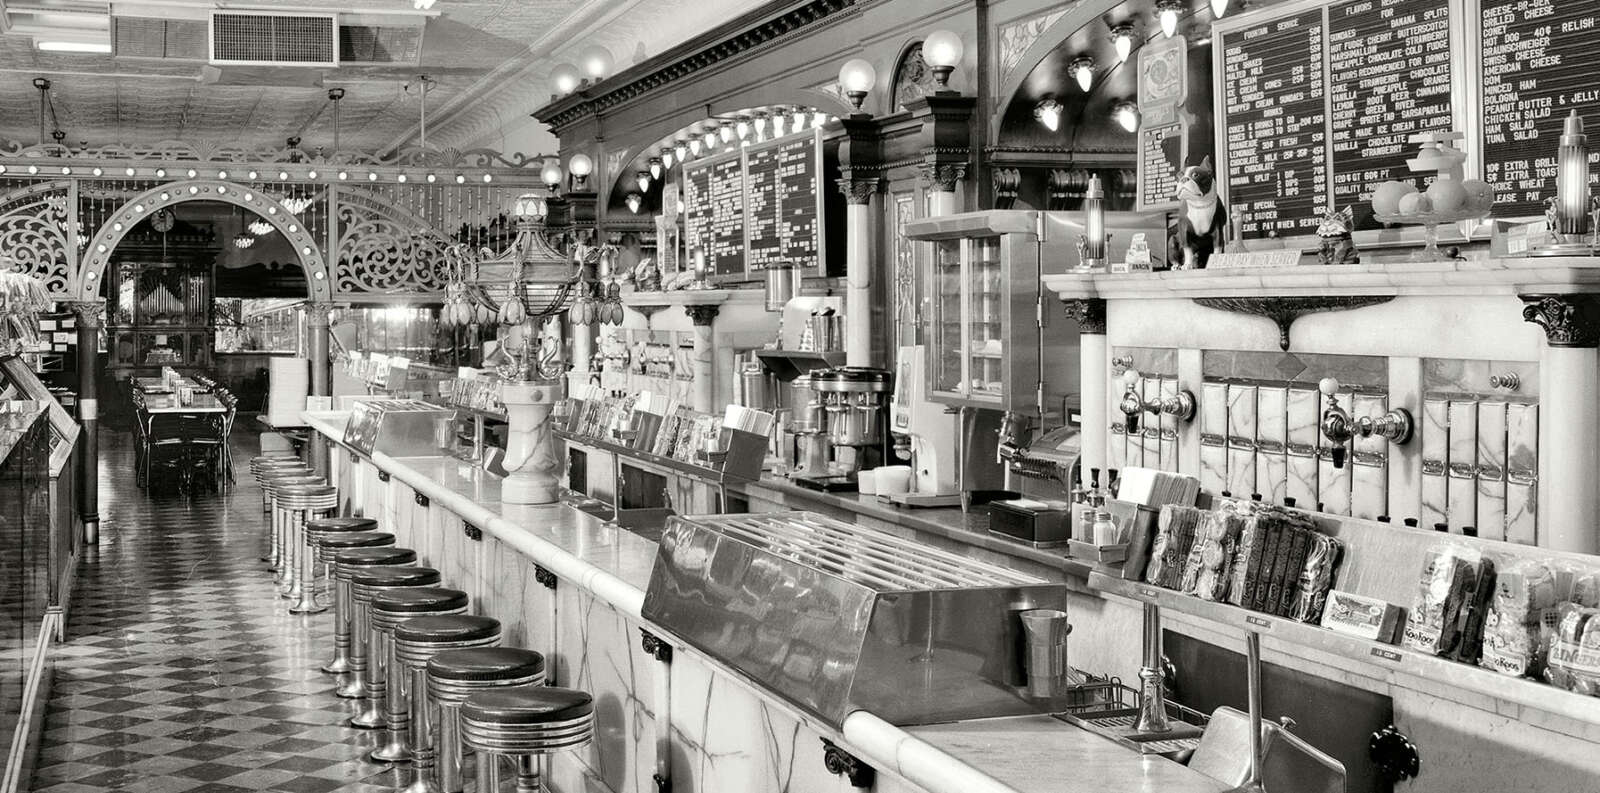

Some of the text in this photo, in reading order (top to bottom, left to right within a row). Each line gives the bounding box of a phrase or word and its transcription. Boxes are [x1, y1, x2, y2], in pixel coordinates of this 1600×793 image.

[1346, 2, 1373, 15] FLAVORS
[1381, 8, 1394, 18] FOR
[1483, 5, 1554, 28] GRILLED CHEESE
[1277, 18, 1299, 31] SERVICE
[1330, 7, 1449, 42] SUNDAES BANANA SPLITS
[1483, 25, 1507, 38] CONEY
[1331, 20, 1449, 53] HOT FUDGE CHERRY BUTTERSCOTCH
[1483, 17, 1594, 47] HOT DOG 40¢ RELISH
[1331, 29, 1449, 62] MARSHMALLOW STRAWBERRY
[1483, 36, 1550, 57] BRAUNSCHWEIGER
[1331, 39, 1449, 71] PINEAPPLE CHOCOLATE COLD FUDGE
[1484, 47, 1546, 66] SWISS CHEESE
[1227, 63, 1239, 73] MILK
[1331, 51, 1450, 82] FLAVORS RECOMMENDED FOR DRINKS
[1484, 54, 1561, 76] AMERICAN CHEESE
[1226, 65, 1263, 80] MALTED MILK
[1331, 63, 1450, 93] COKE STRAWBERRY CHOCOLATE
[1227, 80, 1235, 89] ICE
[1239, 76, 1257, 86] CREAM
[1227, 89, 1236, 97] ICE
[1240, 84, 1257, 95] CREAM
[1292, 74, 1304, 84] 25¢
[1484, 75, 1500, 86] GOM
[1484, 79, 1537, 95] MINCED HAM
[1332, 74, 1450, 102] VANILLA PINEAPPLE ORANGE
[1227, 96, 1237, 105] HOT
[1255, 97, 1273, 108] CREAM
[1333, 84, 1450, 111] LEMON ROOT BEER CINNAMON
[1485, 92, 1519, 105] BOLOGNA
[1485, 90, 1599, 115] PEANUT BUTTER & JELLY
[1333, 99, 1415, 120] CHERRY GREEN RIVER
[1333, 119, 1353, 129] GRAPE
[1401, 103, 1450, 118] SARSAPARILLA
[1484, 107, 1551, 125] CHICKEN SALAD
[1254, 119, 1274, 130] DRINKS
[1275, 117, 1283, 126] TO
[1287, 115, 1295, 124] GO
[1333, 116, 1451, 140] HOME MADE ICE CREAM FLAVORS
[1485, 120, 1535, 135] HAM SALAD
[1255, 127, 1274, 138] DRINKS
[1275, 126, 1283, 135] TO
[1486, 129, 1538, 144] TUNA SALAD
[1279, 137, 1298, 147] FRESH
[1333, 134, 1406, 152] VANILLA CHOCOLATE
[1229, 147, 1257, 159] LEMONADE
[1361, 144, 1402, 157] STRAWBERRY
[1229, 155, 1259, 167] CHOCOLATE
[1264, 152, 1278, 162] MILK
[1486, 162, 1500, 173] 10¢
[1504, 160, 1529, 171] EXTRA
[1230, 166, 1241, 175] HOT
[1244, 161, 1275, 174] CHOCOLATE
[1380, 169, 1390, 178] PT
[1254, 173, 1270, 183] SPLIT
[1277, 178, 1299, 189] 2 DIPS
[1486, 170, 1530, 183] 5¢ EXTRA
[1335, 184, 1361, 194] QUALITY
[1519, 178, 1546, 190] WHEAT
[1277, 188, 1282, 197] 3
[1285, 187, 1299, 196] DIPS
[1526, 191, 1541, 201] PAY
[1254, 200, 1277, 210] SPECIAL
[1254, 210, 1278, 221] SAUCER
[1262, 219, 1295, 230] PAY WHEN
